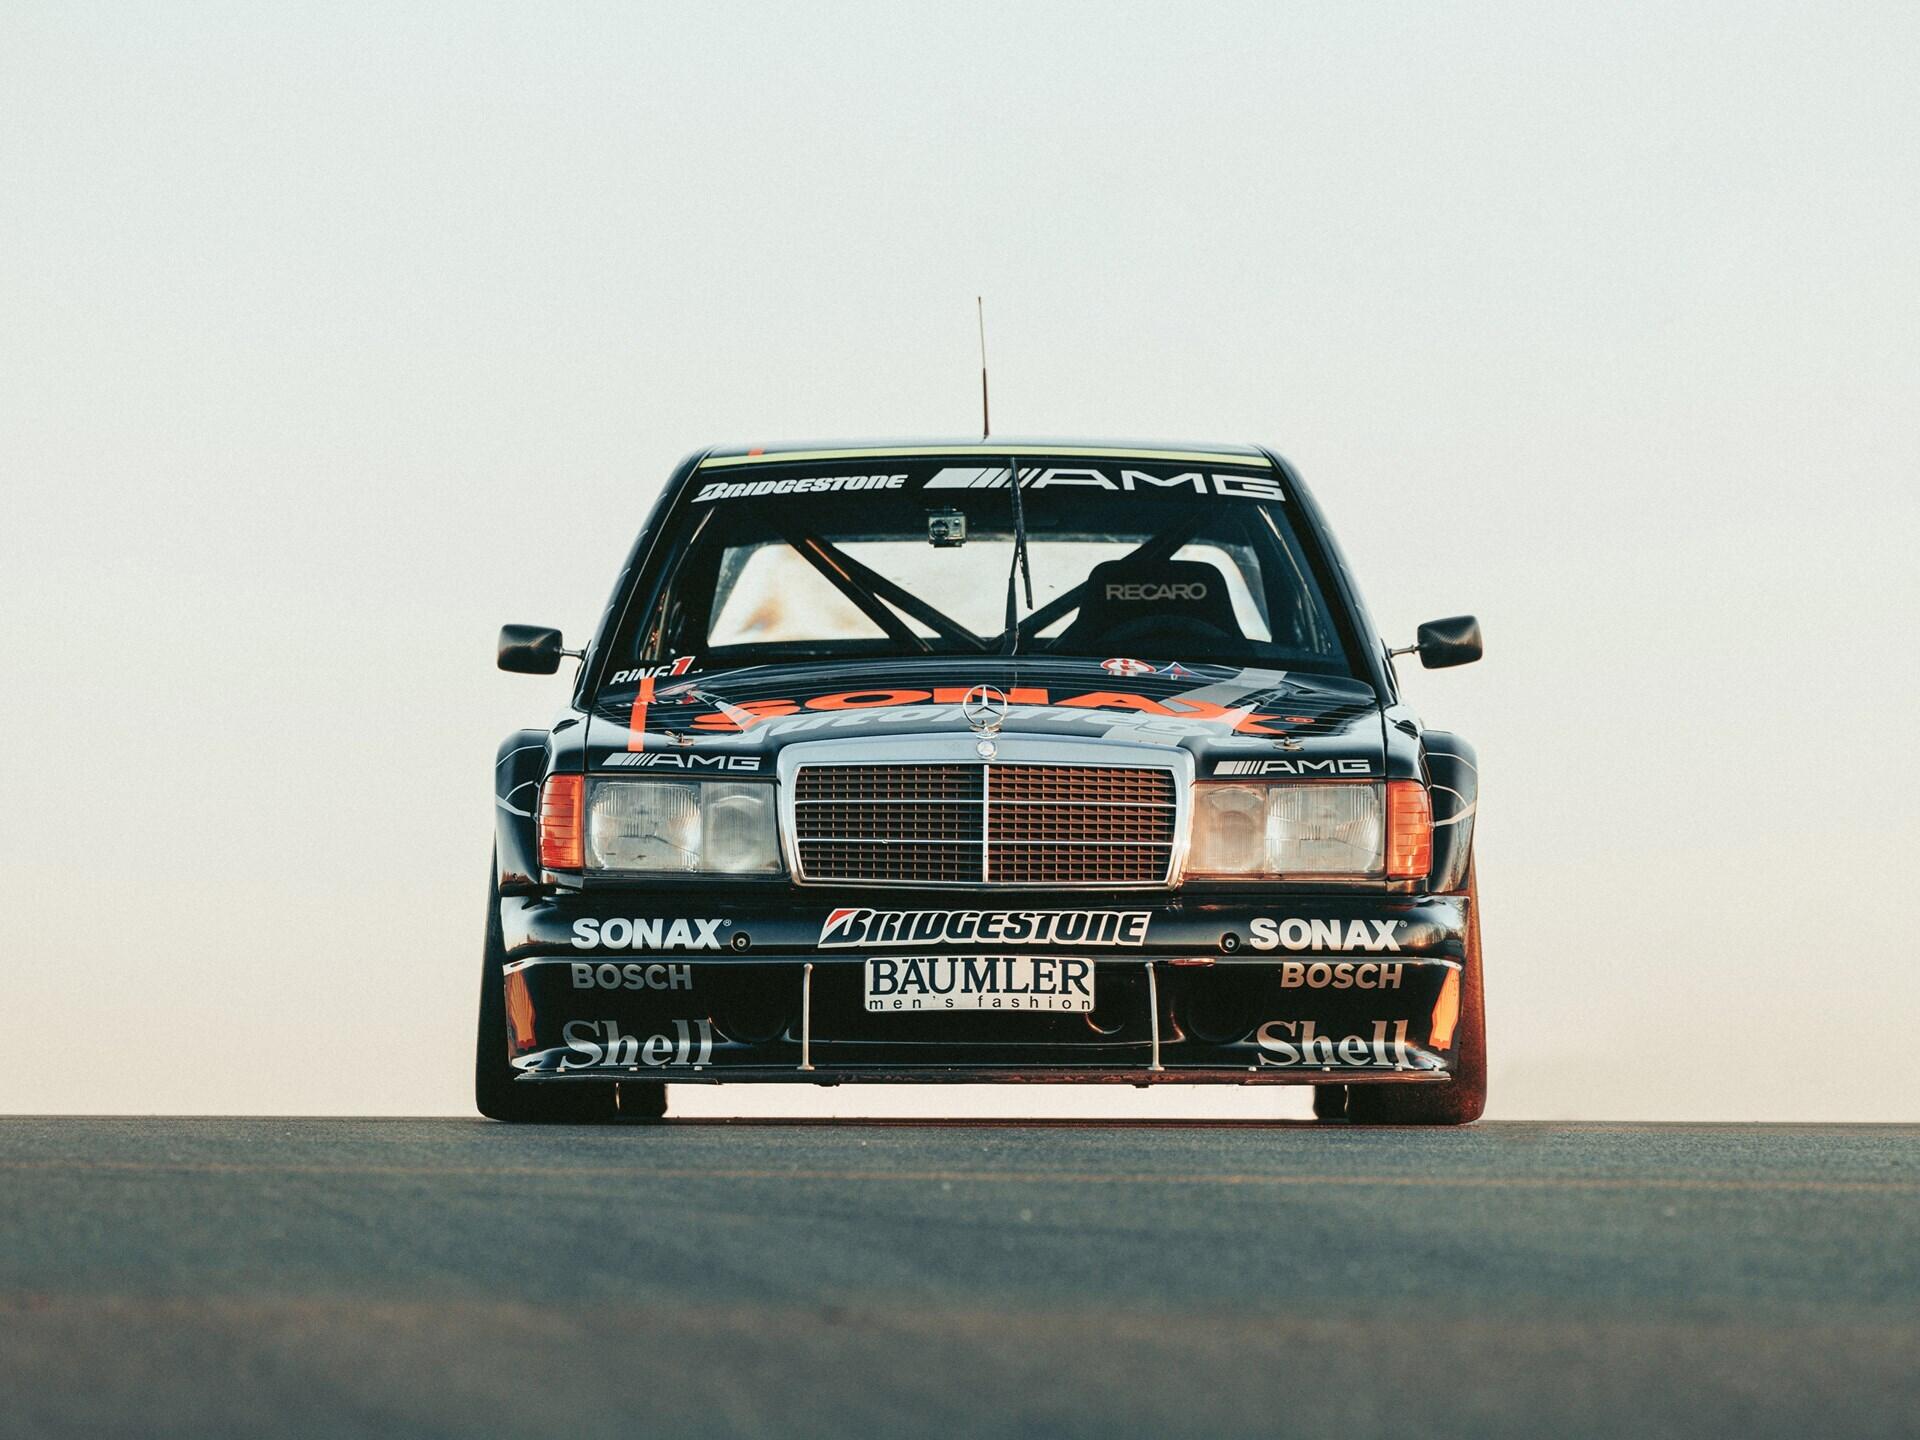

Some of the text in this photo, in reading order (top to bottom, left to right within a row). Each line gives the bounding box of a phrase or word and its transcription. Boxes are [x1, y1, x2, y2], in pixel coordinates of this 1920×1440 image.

[691, 474, 908, 503] BRIDGESTONE
[1105, 583, 1208, 600] RECARO
[818, 908, 1152, 948] BRIDGESTONE
[571, 963, 693, 990] BOSCH
[869, 958, 1090, 996] BÄUMLER
[1280, 962, 1403, 989] BOSCH
[869, 995, 1091, 1010] men's fashion
[560, 1019, 713, 1069] Shell
[1257, 1019, 1414, 1069] Shell
